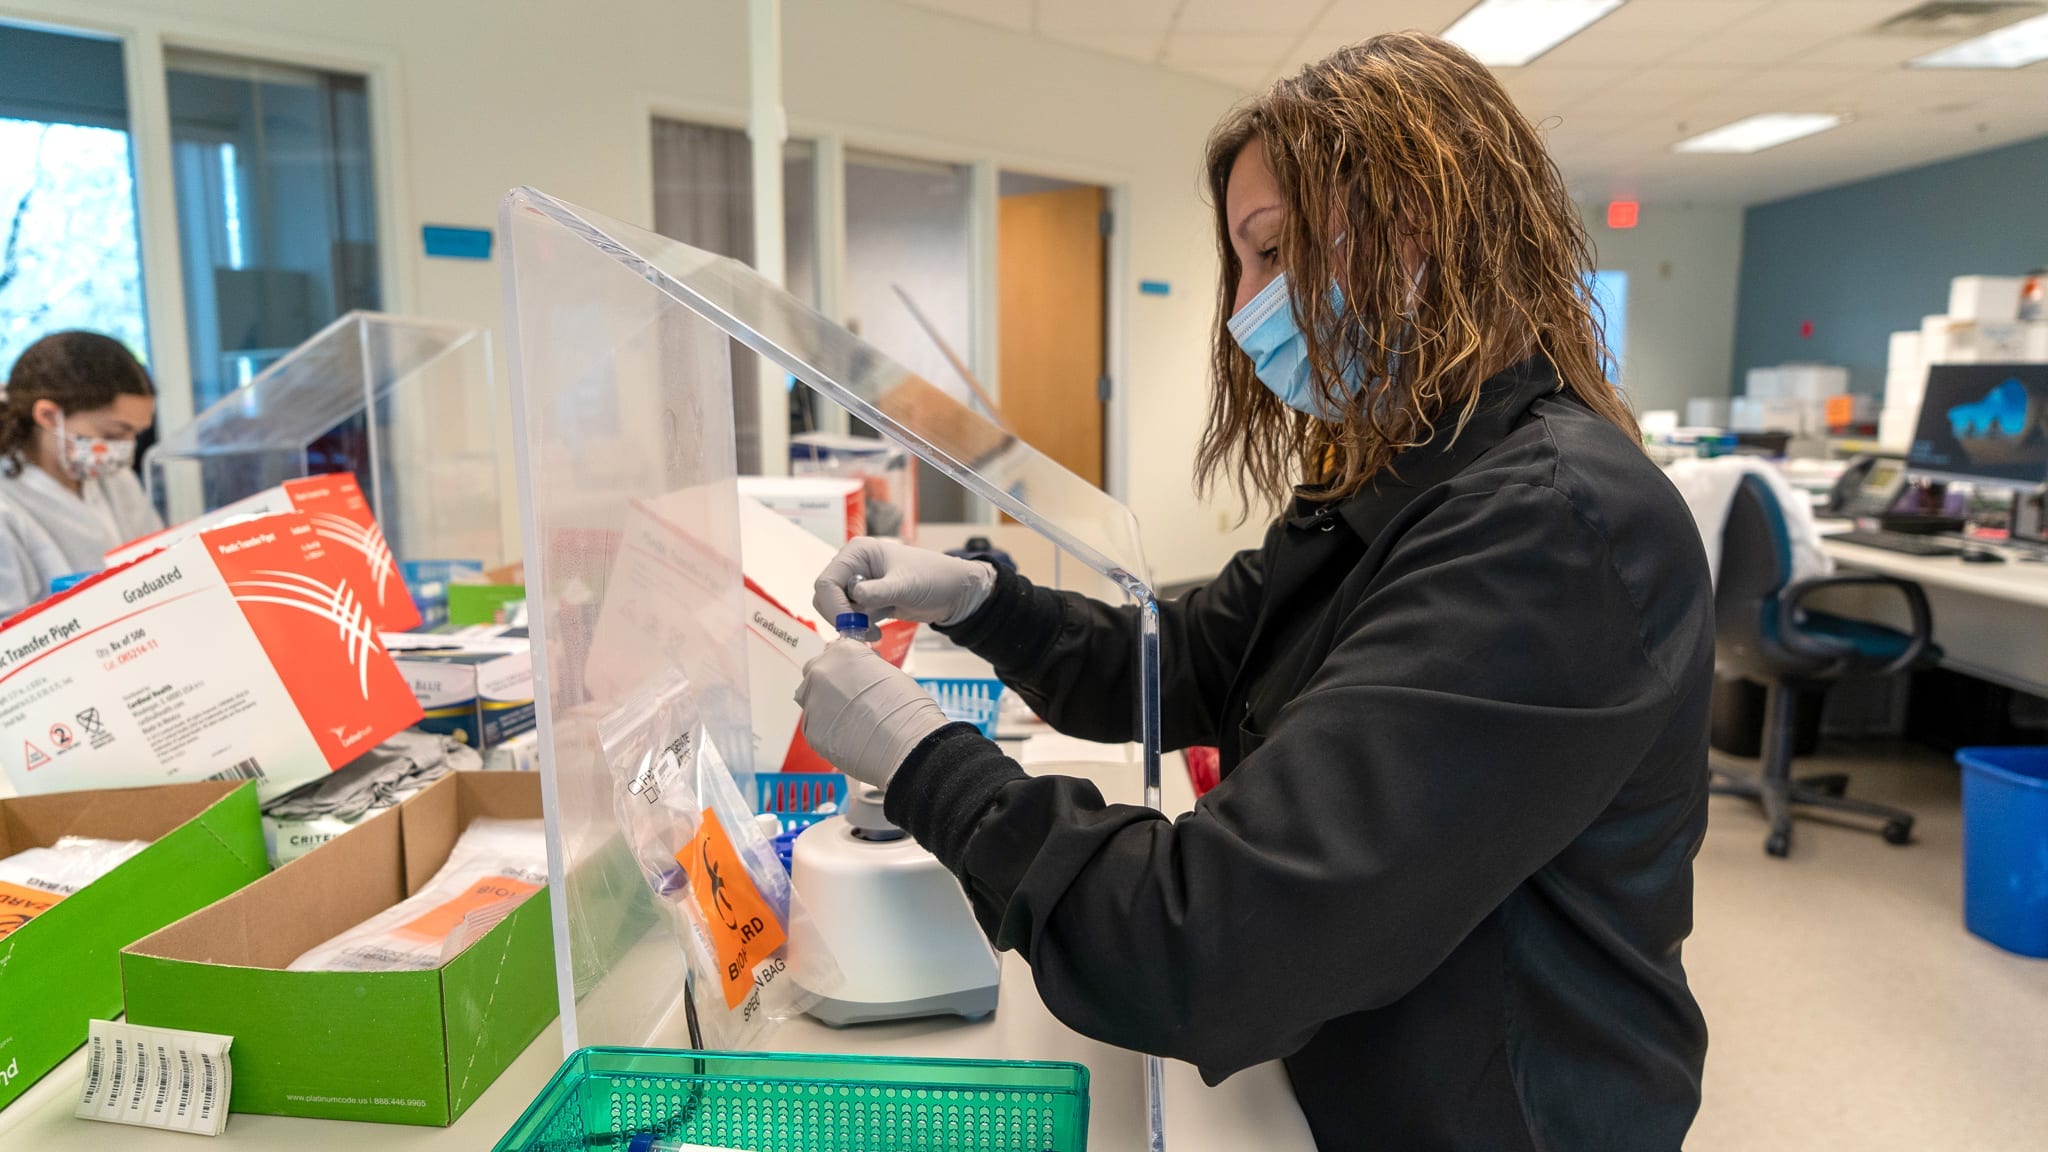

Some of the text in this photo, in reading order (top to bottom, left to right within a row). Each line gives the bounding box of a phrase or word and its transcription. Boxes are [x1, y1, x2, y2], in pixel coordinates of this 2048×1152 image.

[123, 565, 182, 604] Graduated
[6, 634, 50, 664] Transfer
[49, 618, 81, 642] Pipet
[753, 611, 798, 648] Graduated
[290, 833, 338, 846] CRITE
[762, 958, 786, 983] BAG
[286, 1094, 368, 1104] www.platinumcode.us
